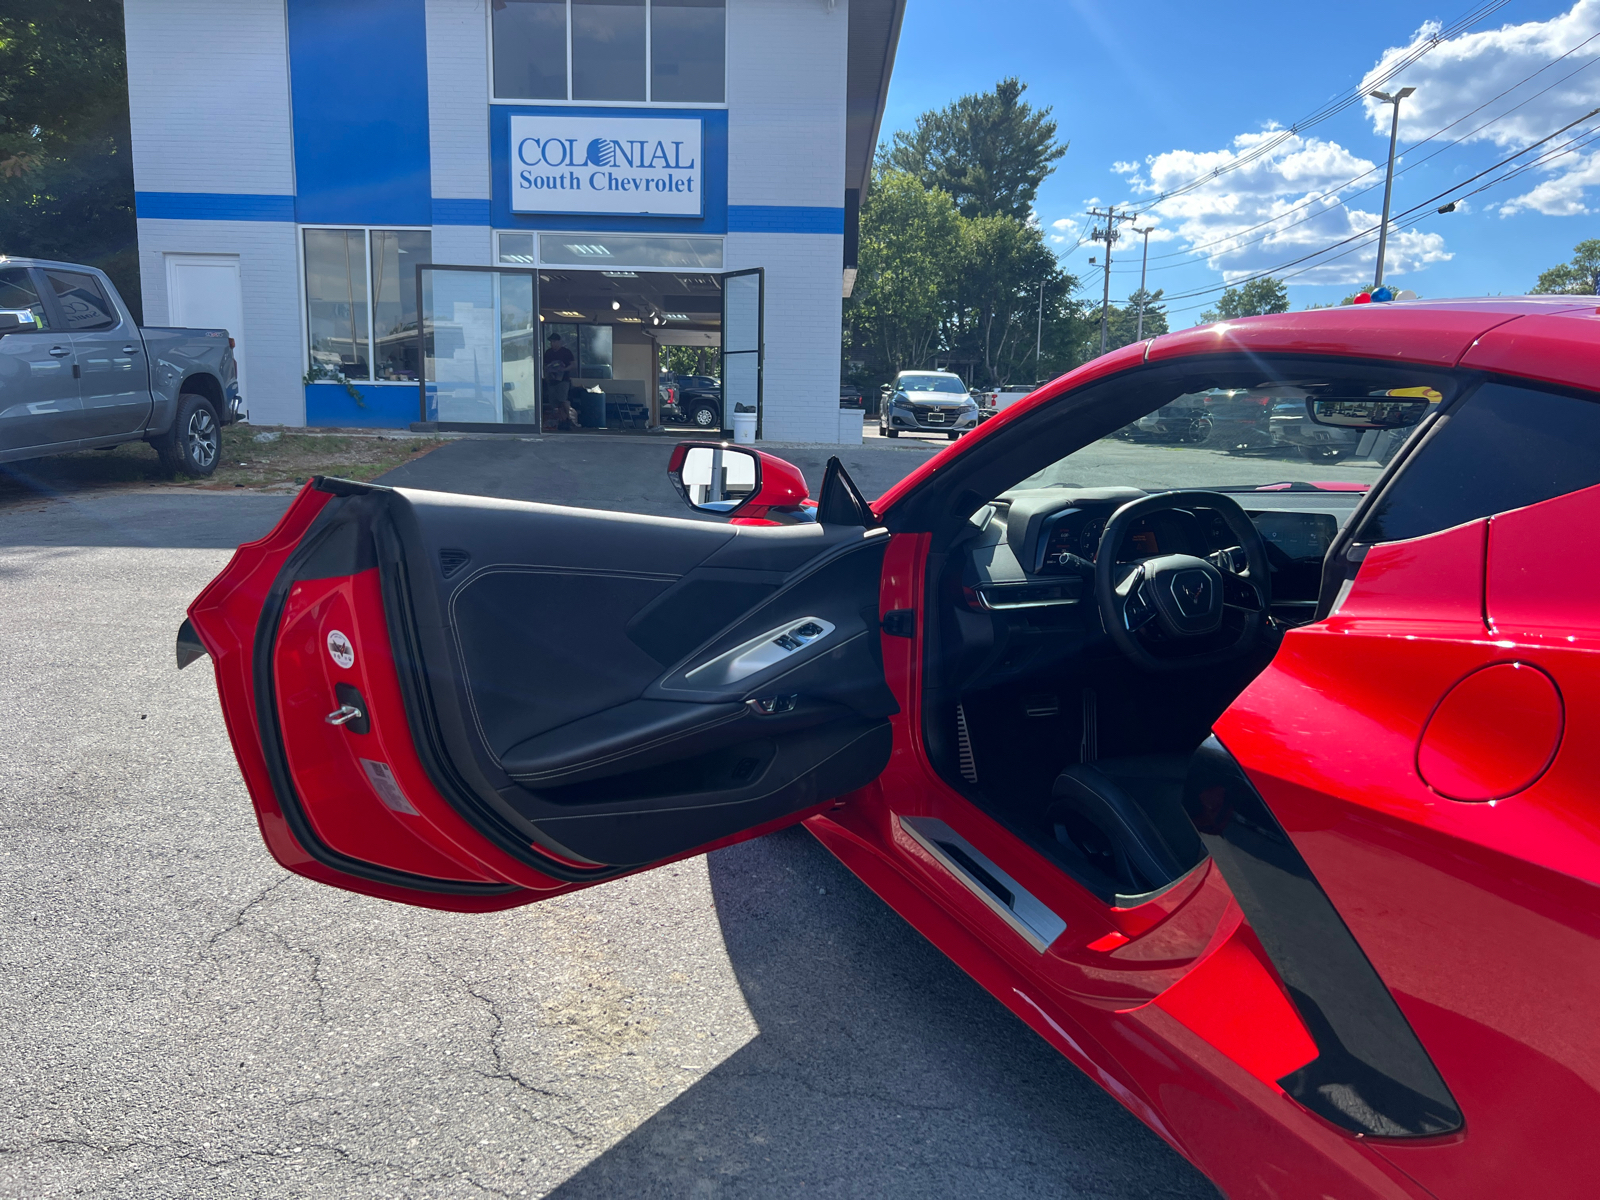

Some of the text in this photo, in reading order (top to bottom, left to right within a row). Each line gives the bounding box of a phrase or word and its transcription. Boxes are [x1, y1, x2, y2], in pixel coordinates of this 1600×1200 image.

[518, 137, 695, 169] COLONIAL
[519, 170, 694, 192] South Chevrolet
